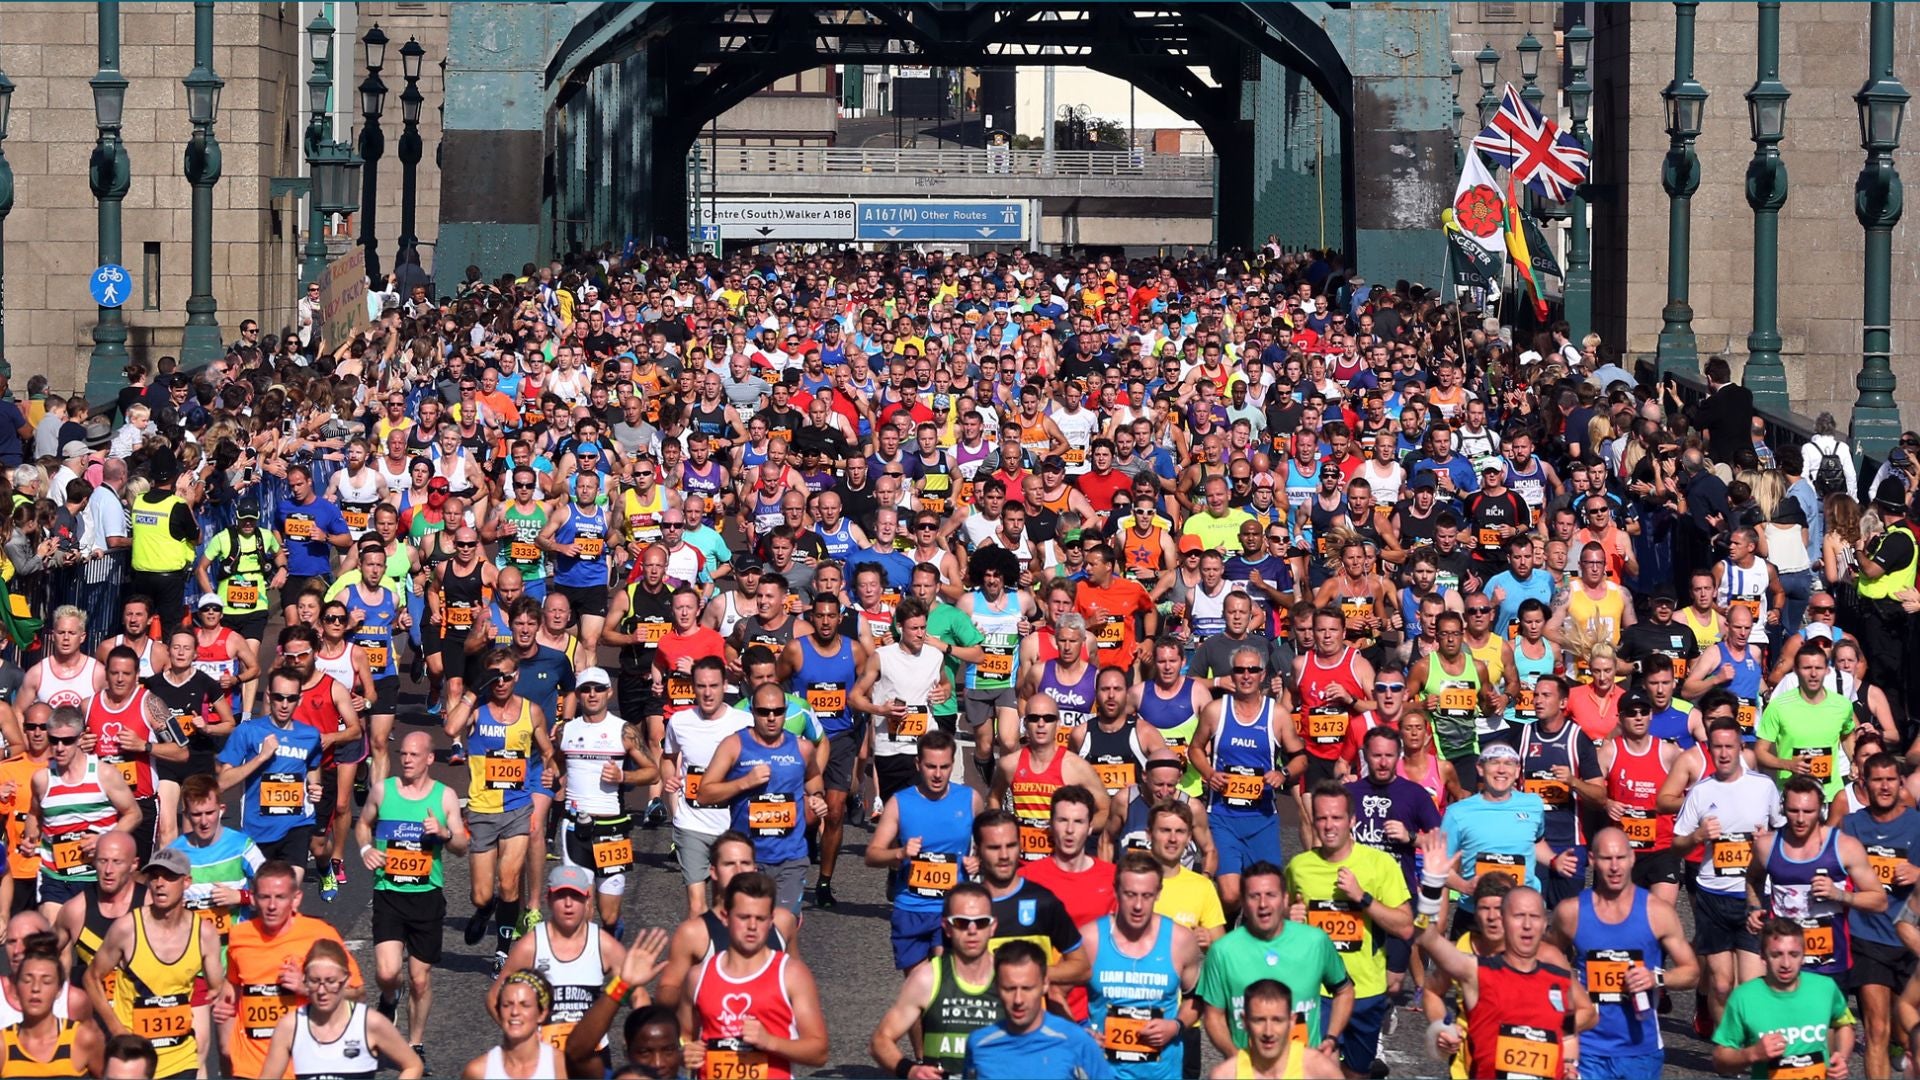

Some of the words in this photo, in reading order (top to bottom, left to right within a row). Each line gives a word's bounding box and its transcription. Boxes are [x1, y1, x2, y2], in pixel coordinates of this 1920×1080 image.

[786, 210, 820, 219] Walker
[922, 210, 949, 220] Other
[954, 210, 987, 220] Routes
[1514, 480, 1541, 488] MICHAEL
[1486, 508, 1504, 516] RICH
[136, 516, 157, 524] POLICE
[514, 548, 538, 557] 3335
[230, 591, 255, 600] 2938
[985, 634, 1010, 646] PAUL
[811, 696, 841, 708] 4829
[1446, 694, 1473, 706] 5115
[480, 724, 506, 738] MARK
[1314, 721, 1344, 733] 3473
[1231, 737, 1258, 748] PAUL
[490, 765, 522, 778] 1206
[1013, 782, 1059, 794] SERPENTIN
[1230, 782, 1261, 796] 2549
[266, 790, 300, 802] 1506
[599, 846, 629, 862] 5133
[1718, 850, 1752, 862] 4847
[390, 858, 427, 870] 2697
[915, 870, 951, 884] 1409
[1100, 971, 1125, 984] LIAM
[1126, 972, 1168, 986] BRITTON
[1103, 986, 1164, 1000] FOUNDATION
[943, 998, 998, 1008] ANTHONY
[942, 1008, 997, 1020] NOLAN
[141, 1016, 186, 1033] 1312
[1504, 1048, 1549, 1069] 6271
[713, 1062, 760, 1080] 5796
